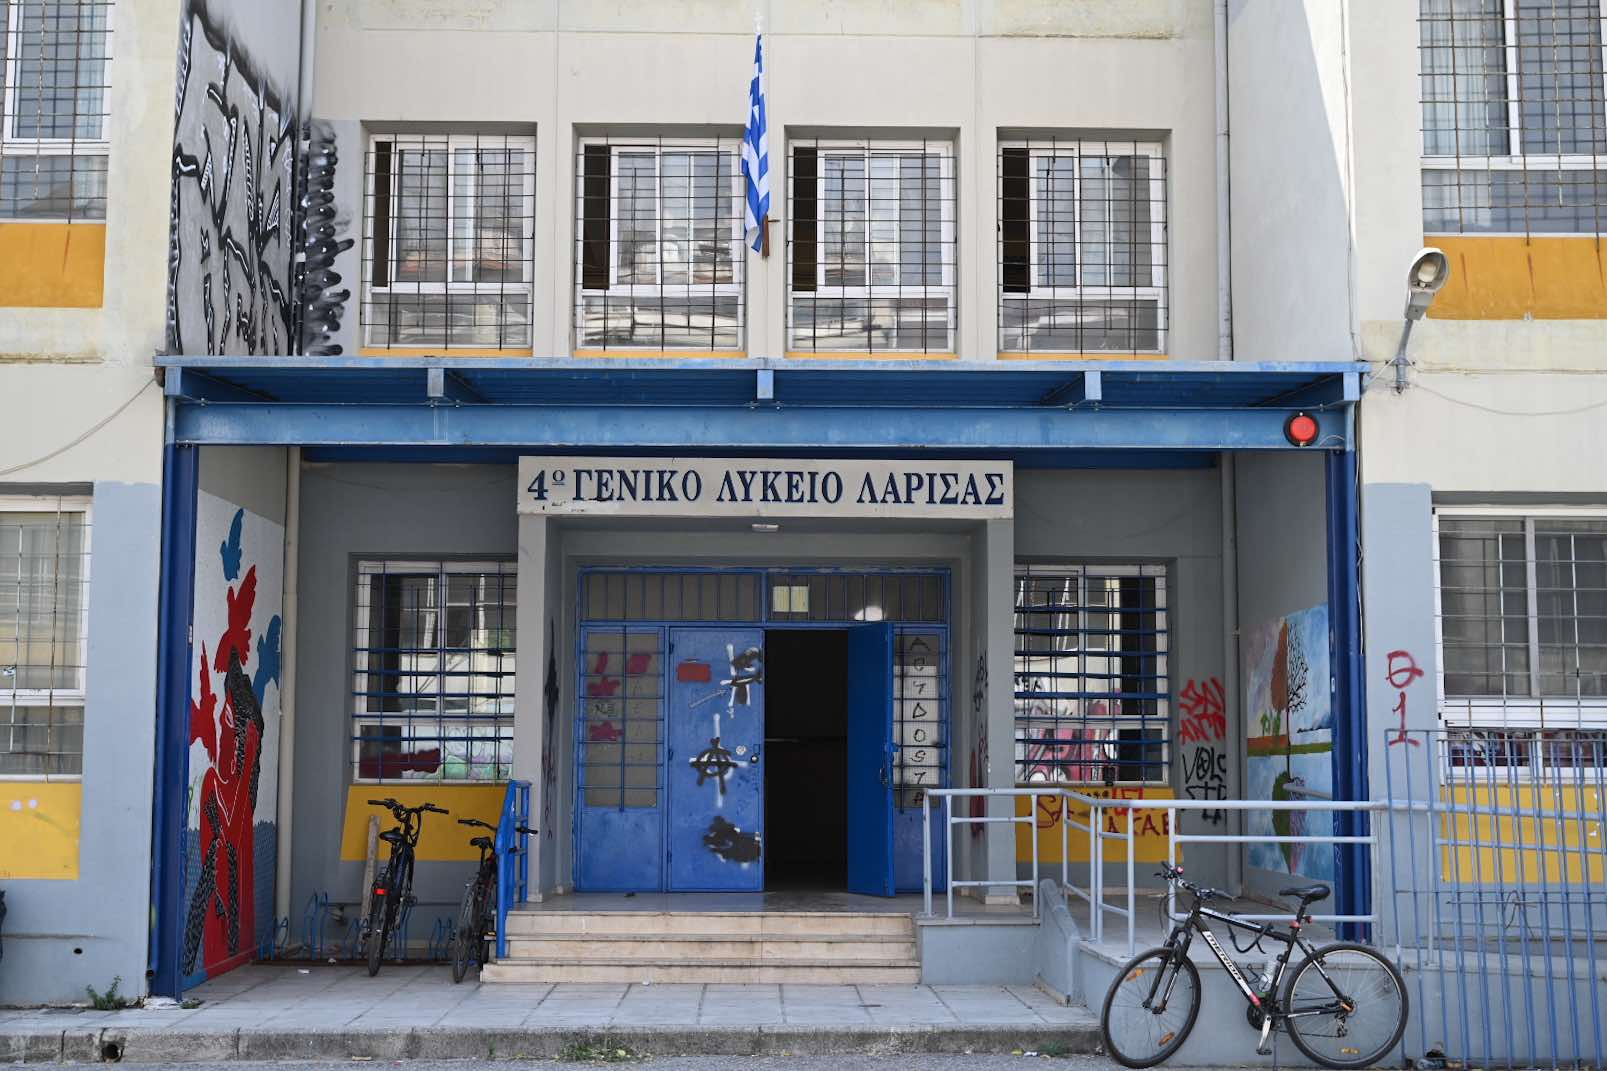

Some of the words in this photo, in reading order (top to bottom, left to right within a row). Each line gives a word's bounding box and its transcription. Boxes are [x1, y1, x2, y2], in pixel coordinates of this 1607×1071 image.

[572, 468, 702, 502] ΓΕΝΙΚΟ
[716, 470, 843, 503] ΛΥΚΕΙΟ
[856, 472, 1005, 504] ΛΑΡΙΣΑΣ
